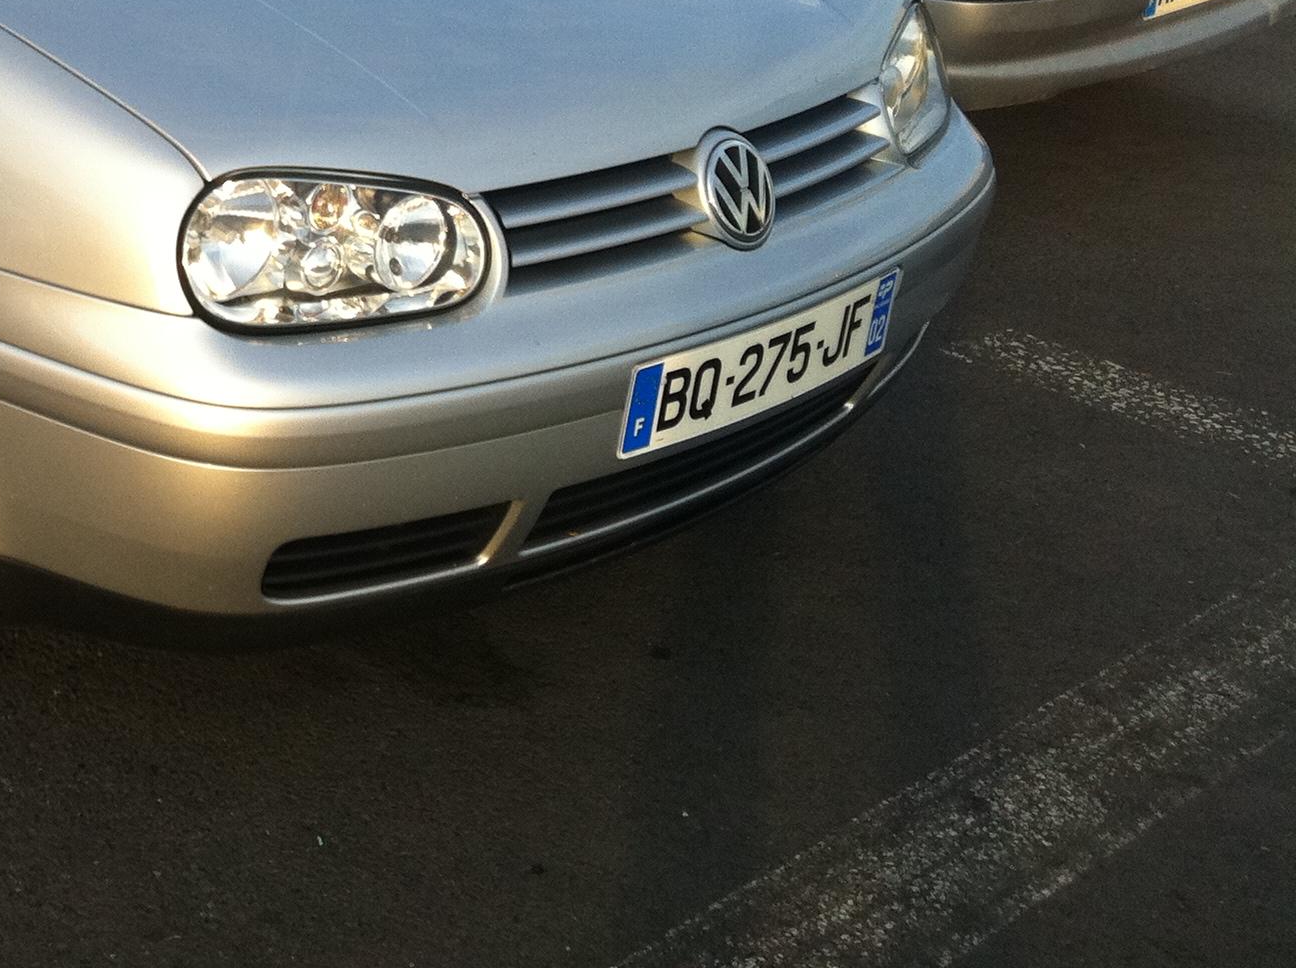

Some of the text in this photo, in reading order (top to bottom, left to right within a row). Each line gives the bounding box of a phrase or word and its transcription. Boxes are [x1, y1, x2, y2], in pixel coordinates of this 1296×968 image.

[868, 314, 887, 347] 02
[656, 294, 872, 432] BQ-275-JF
[633, 417, 645, 438] F
